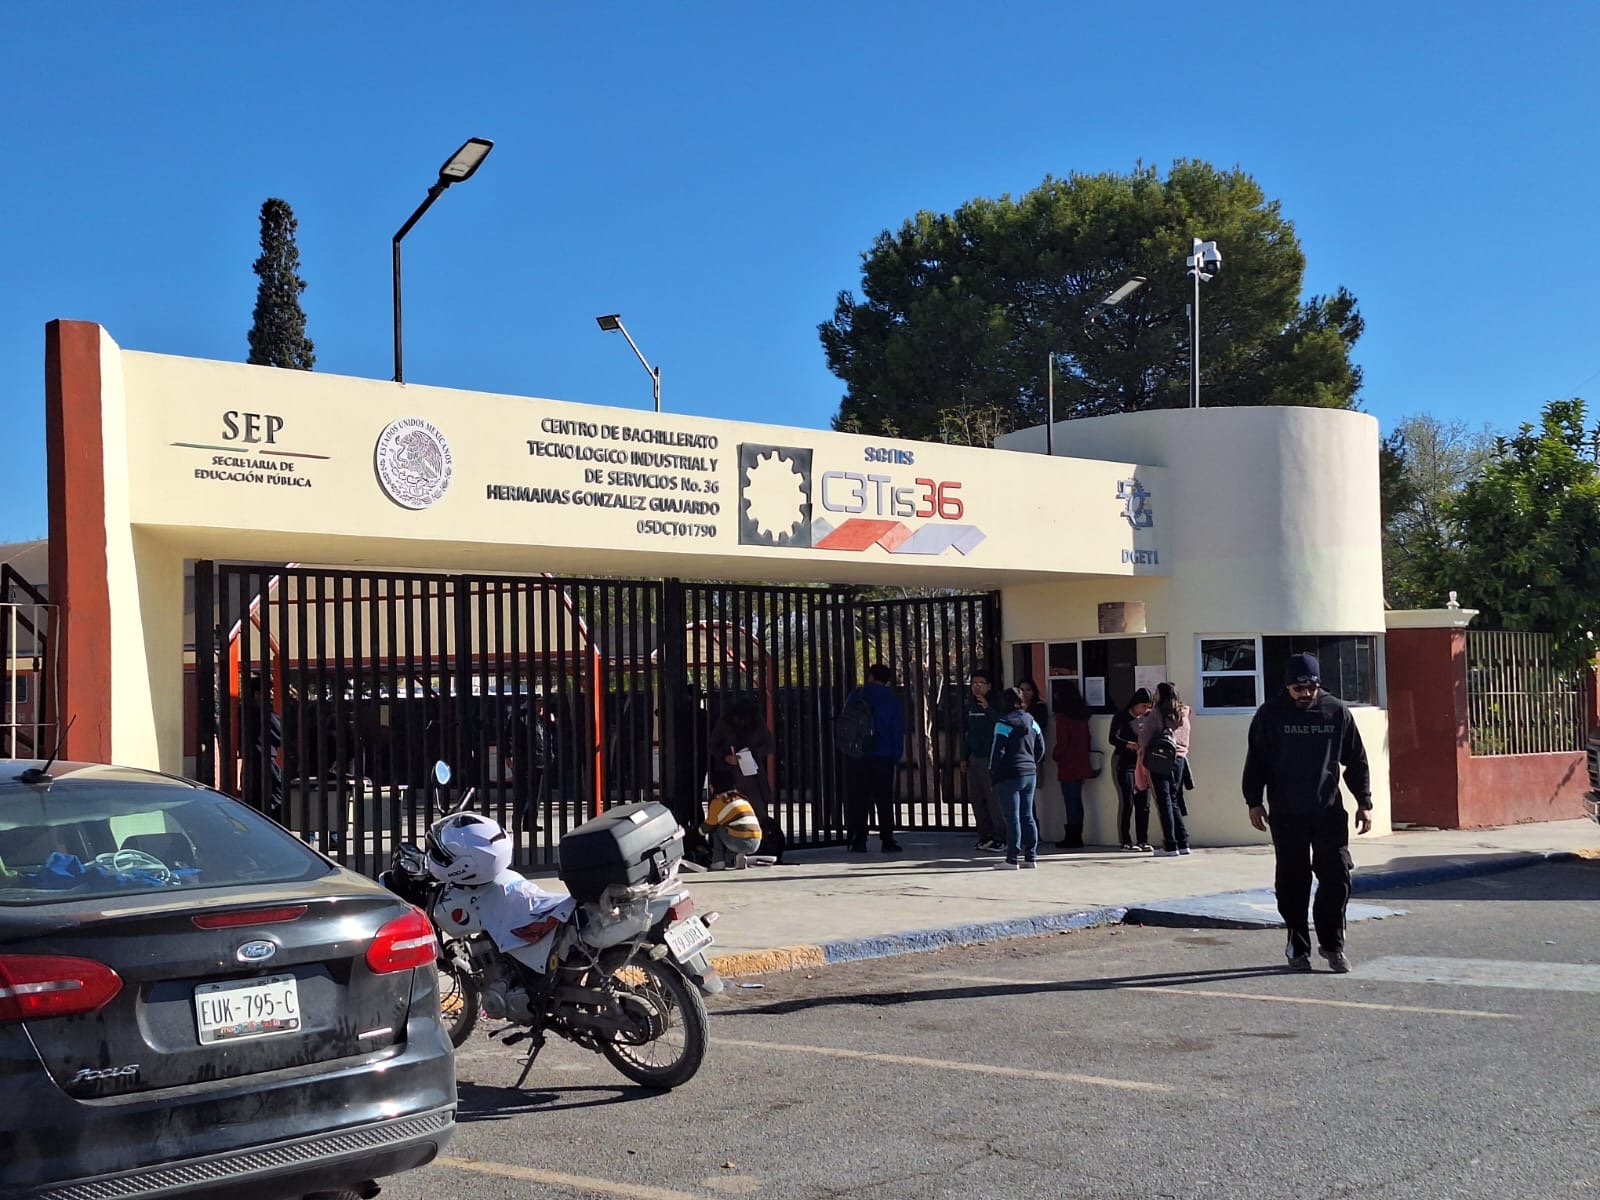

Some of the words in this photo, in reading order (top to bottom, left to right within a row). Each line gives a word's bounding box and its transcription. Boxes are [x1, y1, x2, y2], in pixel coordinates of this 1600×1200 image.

[221, 410, 284, 444] SEP
[541, 417, 598, 438] CENTRO
[601, 424, 620, 440] DE
[622, 427, 718, 449] BACHILLERATO
[379, 424, 399, 457] ESTADOS
[398, 418, 425, 429] UNIDOS
[426, 422, 453, 465] MEXICANOS
[211, 456, 278, 471] SECRETARIA
[280, 461, 295, 472] DE
[527, 440, 628, 465] TECNOLOGICO
[630, 451, 708, 472] INDUSTRIAL
[709, 458, 718, 472] Y
[194, 468, 264, 484] EDUCACIÓN
[266, 473, 312, 488] PÚBLICA
[584, 468, 604, 484] DE
[608, 470, 678, 490] SERVICIOS
[680, 477, 702, 493] No.
[703, 479, 720, 494] 36
[486, 484, 571, 505] HERMANAS
[572, 489, 647, 511] GONZALEZ
[649, 498, 720, 516] GUAJARDO
[636, 519, 717, 538] 05DCT01790
[1121, 548, 1160, 565] DGETI
[1283, 724, 1310, 734] DALE
[1311, 724, 1336, 734] PLAY
[244, 945, 268, 958] Ford
[200, 990, 295, 1026] EUK-795-C
